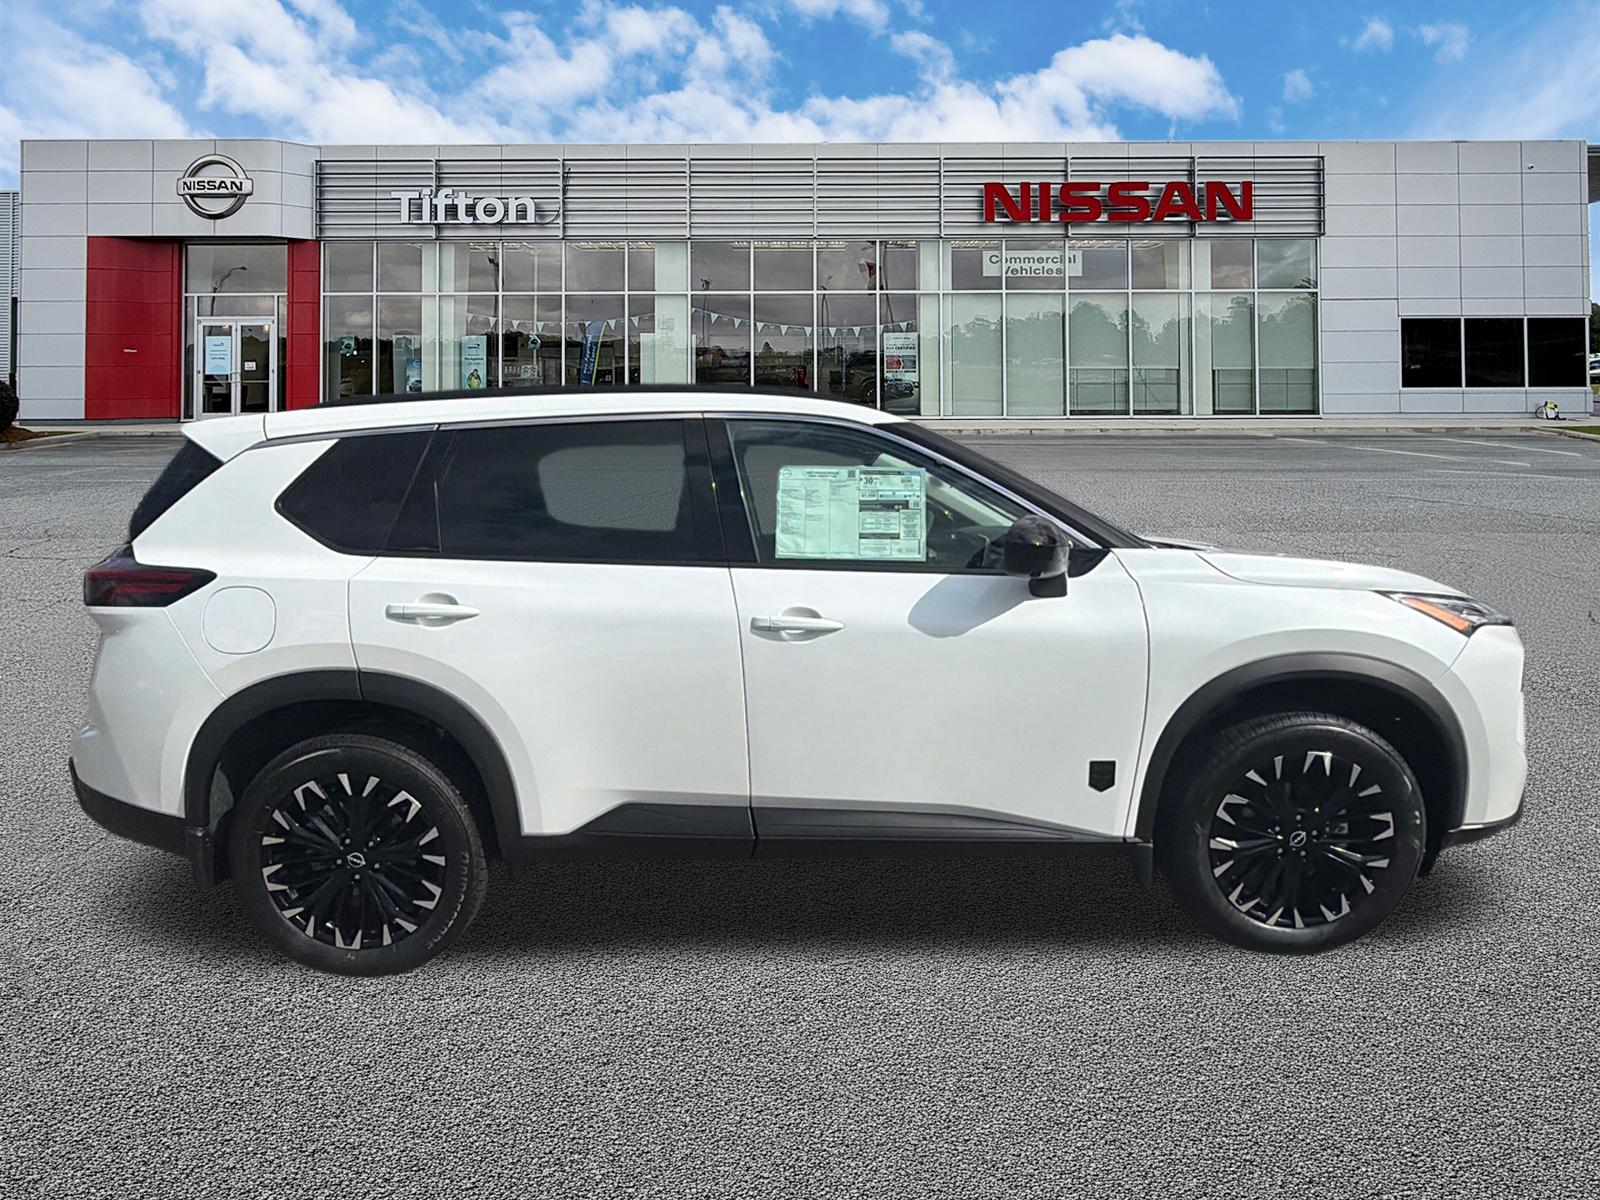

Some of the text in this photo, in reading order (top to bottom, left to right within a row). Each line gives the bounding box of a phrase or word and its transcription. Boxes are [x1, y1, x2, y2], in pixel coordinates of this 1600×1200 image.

[182, 181, 243, 192] NISSAN
[983, 181, 1253, 223] NISSAN
[391, 188, 536, 224] Tifton
